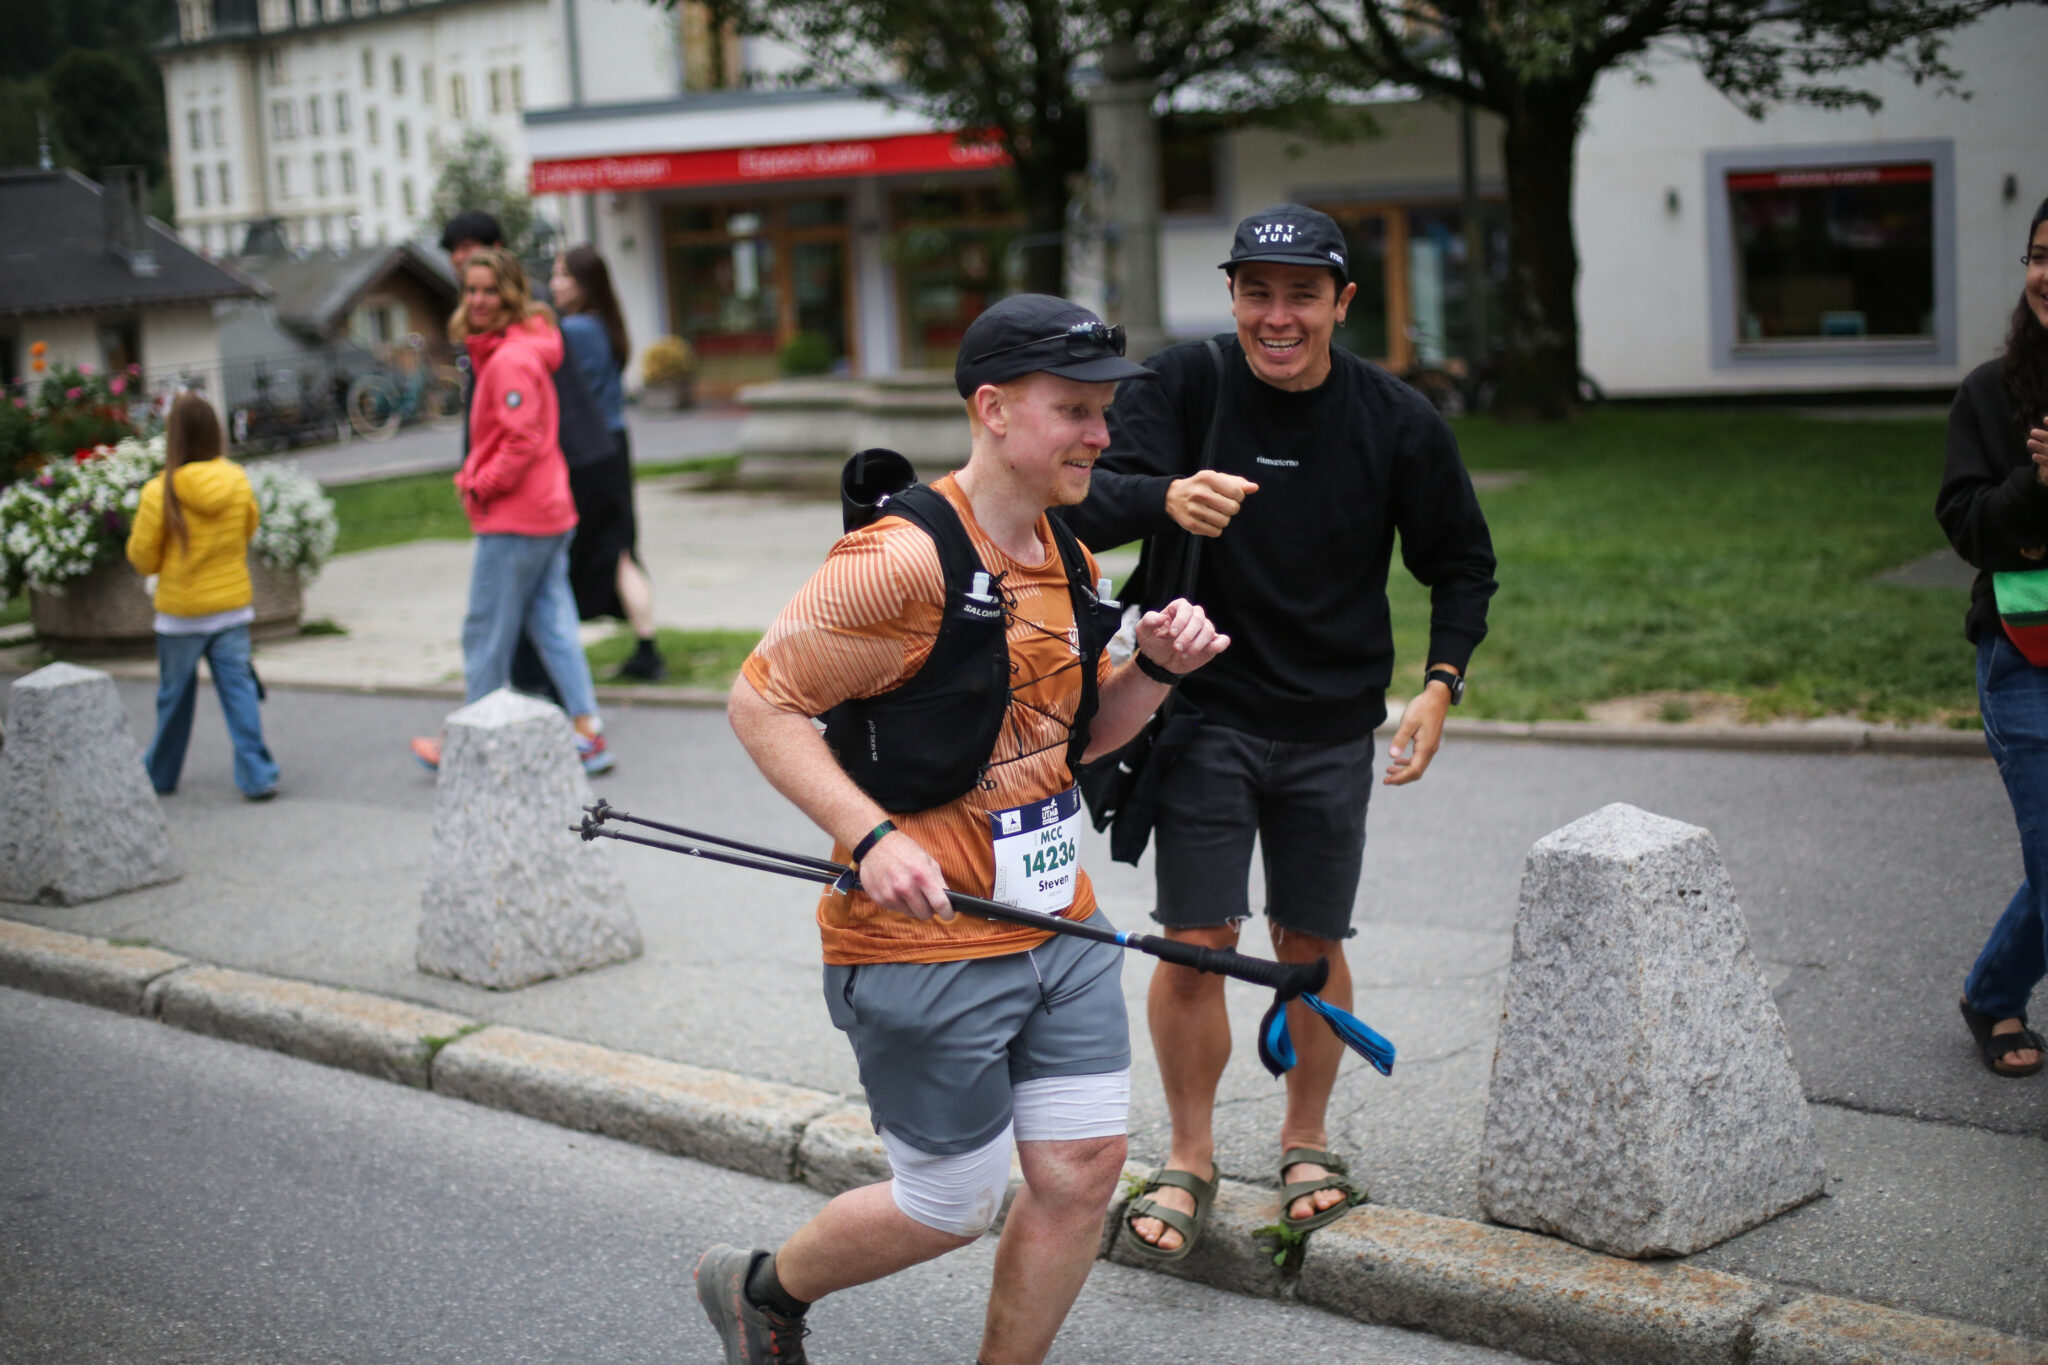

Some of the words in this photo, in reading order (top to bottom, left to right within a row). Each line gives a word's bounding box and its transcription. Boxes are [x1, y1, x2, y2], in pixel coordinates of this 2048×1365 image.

[1259, 234, 1293, 243] RUN
[963, 604, 1001, 618] SALOMO
[1041, 826, 1063, 845] MCC
[1022, 837, 1076, 878] 14236
[1038, 874, 1069, 892] Steven
